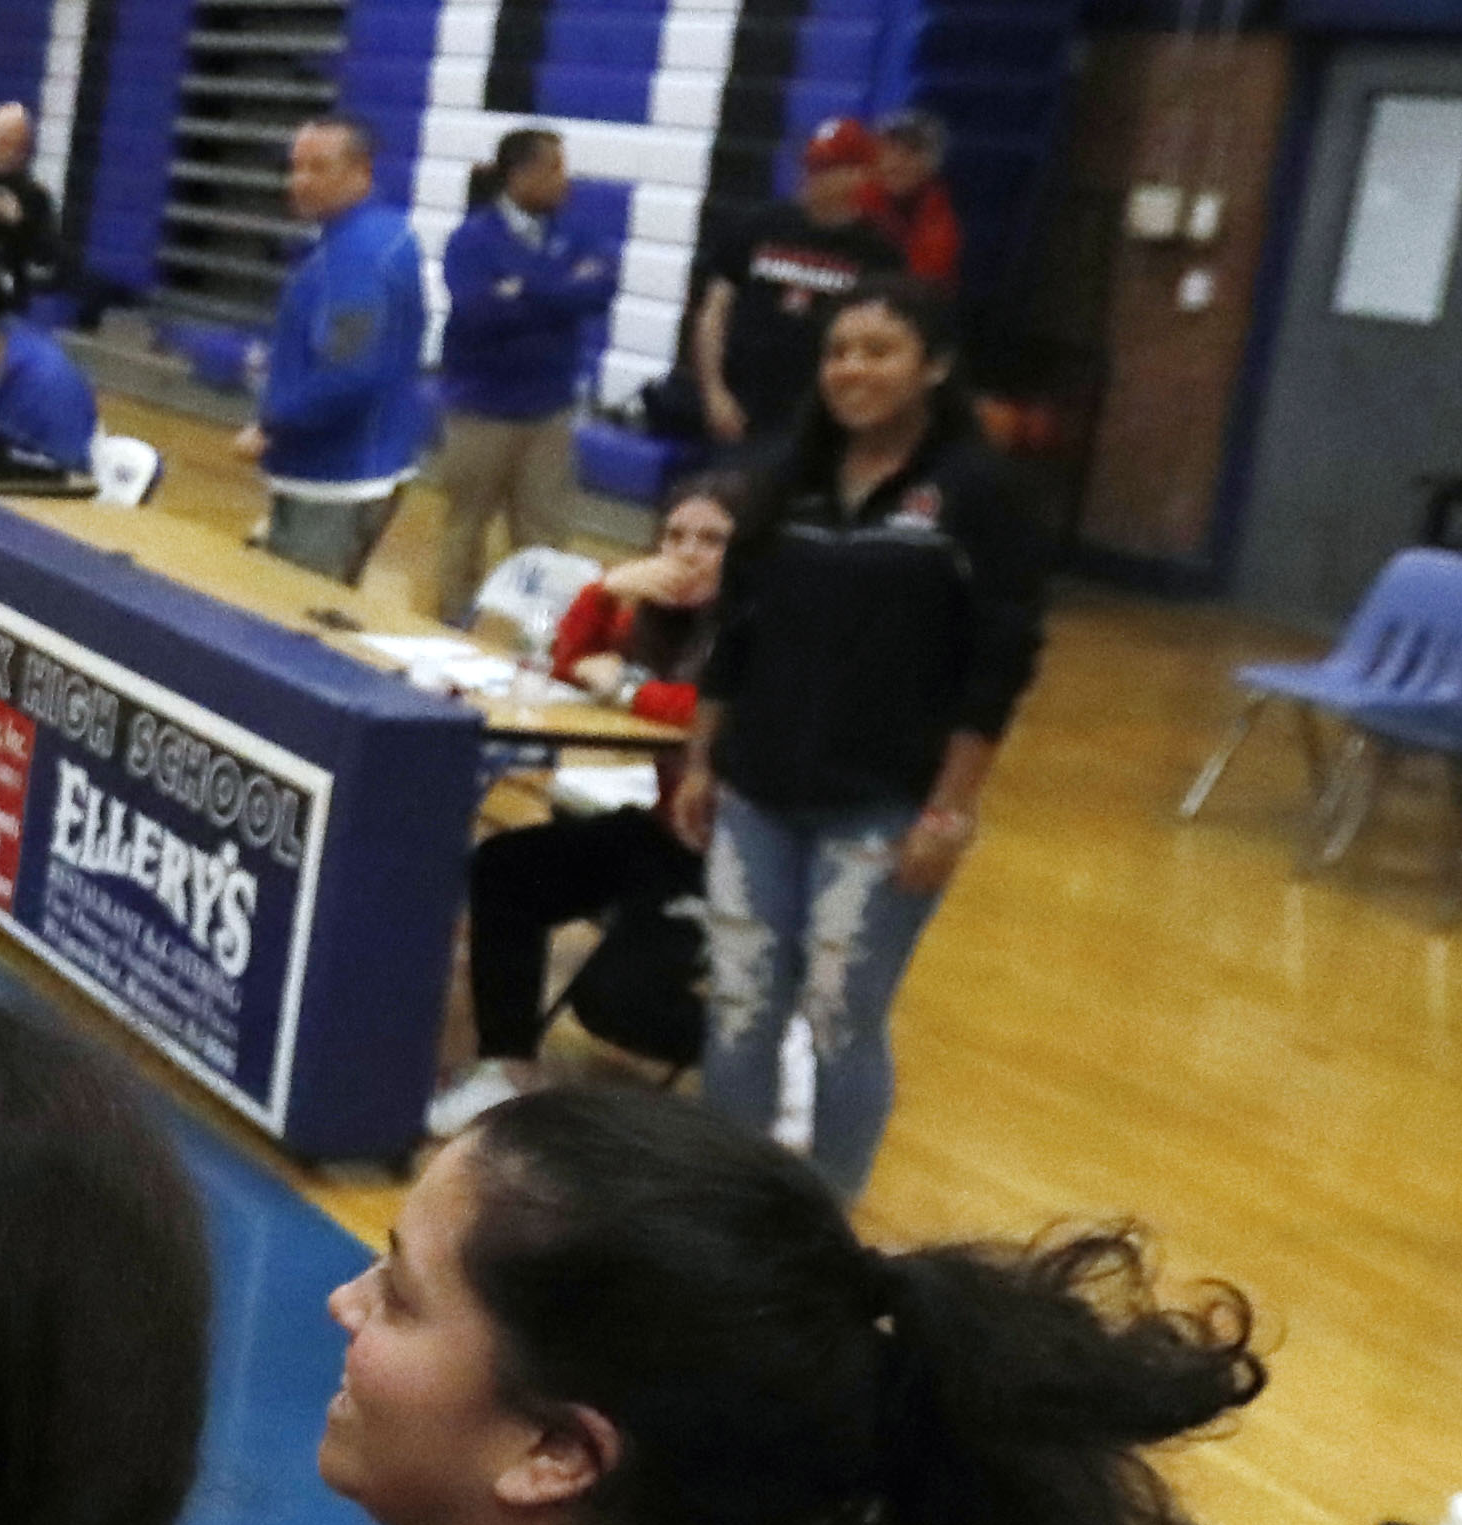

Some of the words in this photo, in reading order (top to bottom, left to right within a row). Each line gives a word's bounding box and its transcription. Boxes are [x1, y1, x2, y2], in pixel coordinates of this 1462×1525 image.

[20, 648, 119, 759] HIGH
[126, 712, 303, 867] SCHOOL
[50, 757, 258, 980] ELLERY'S
